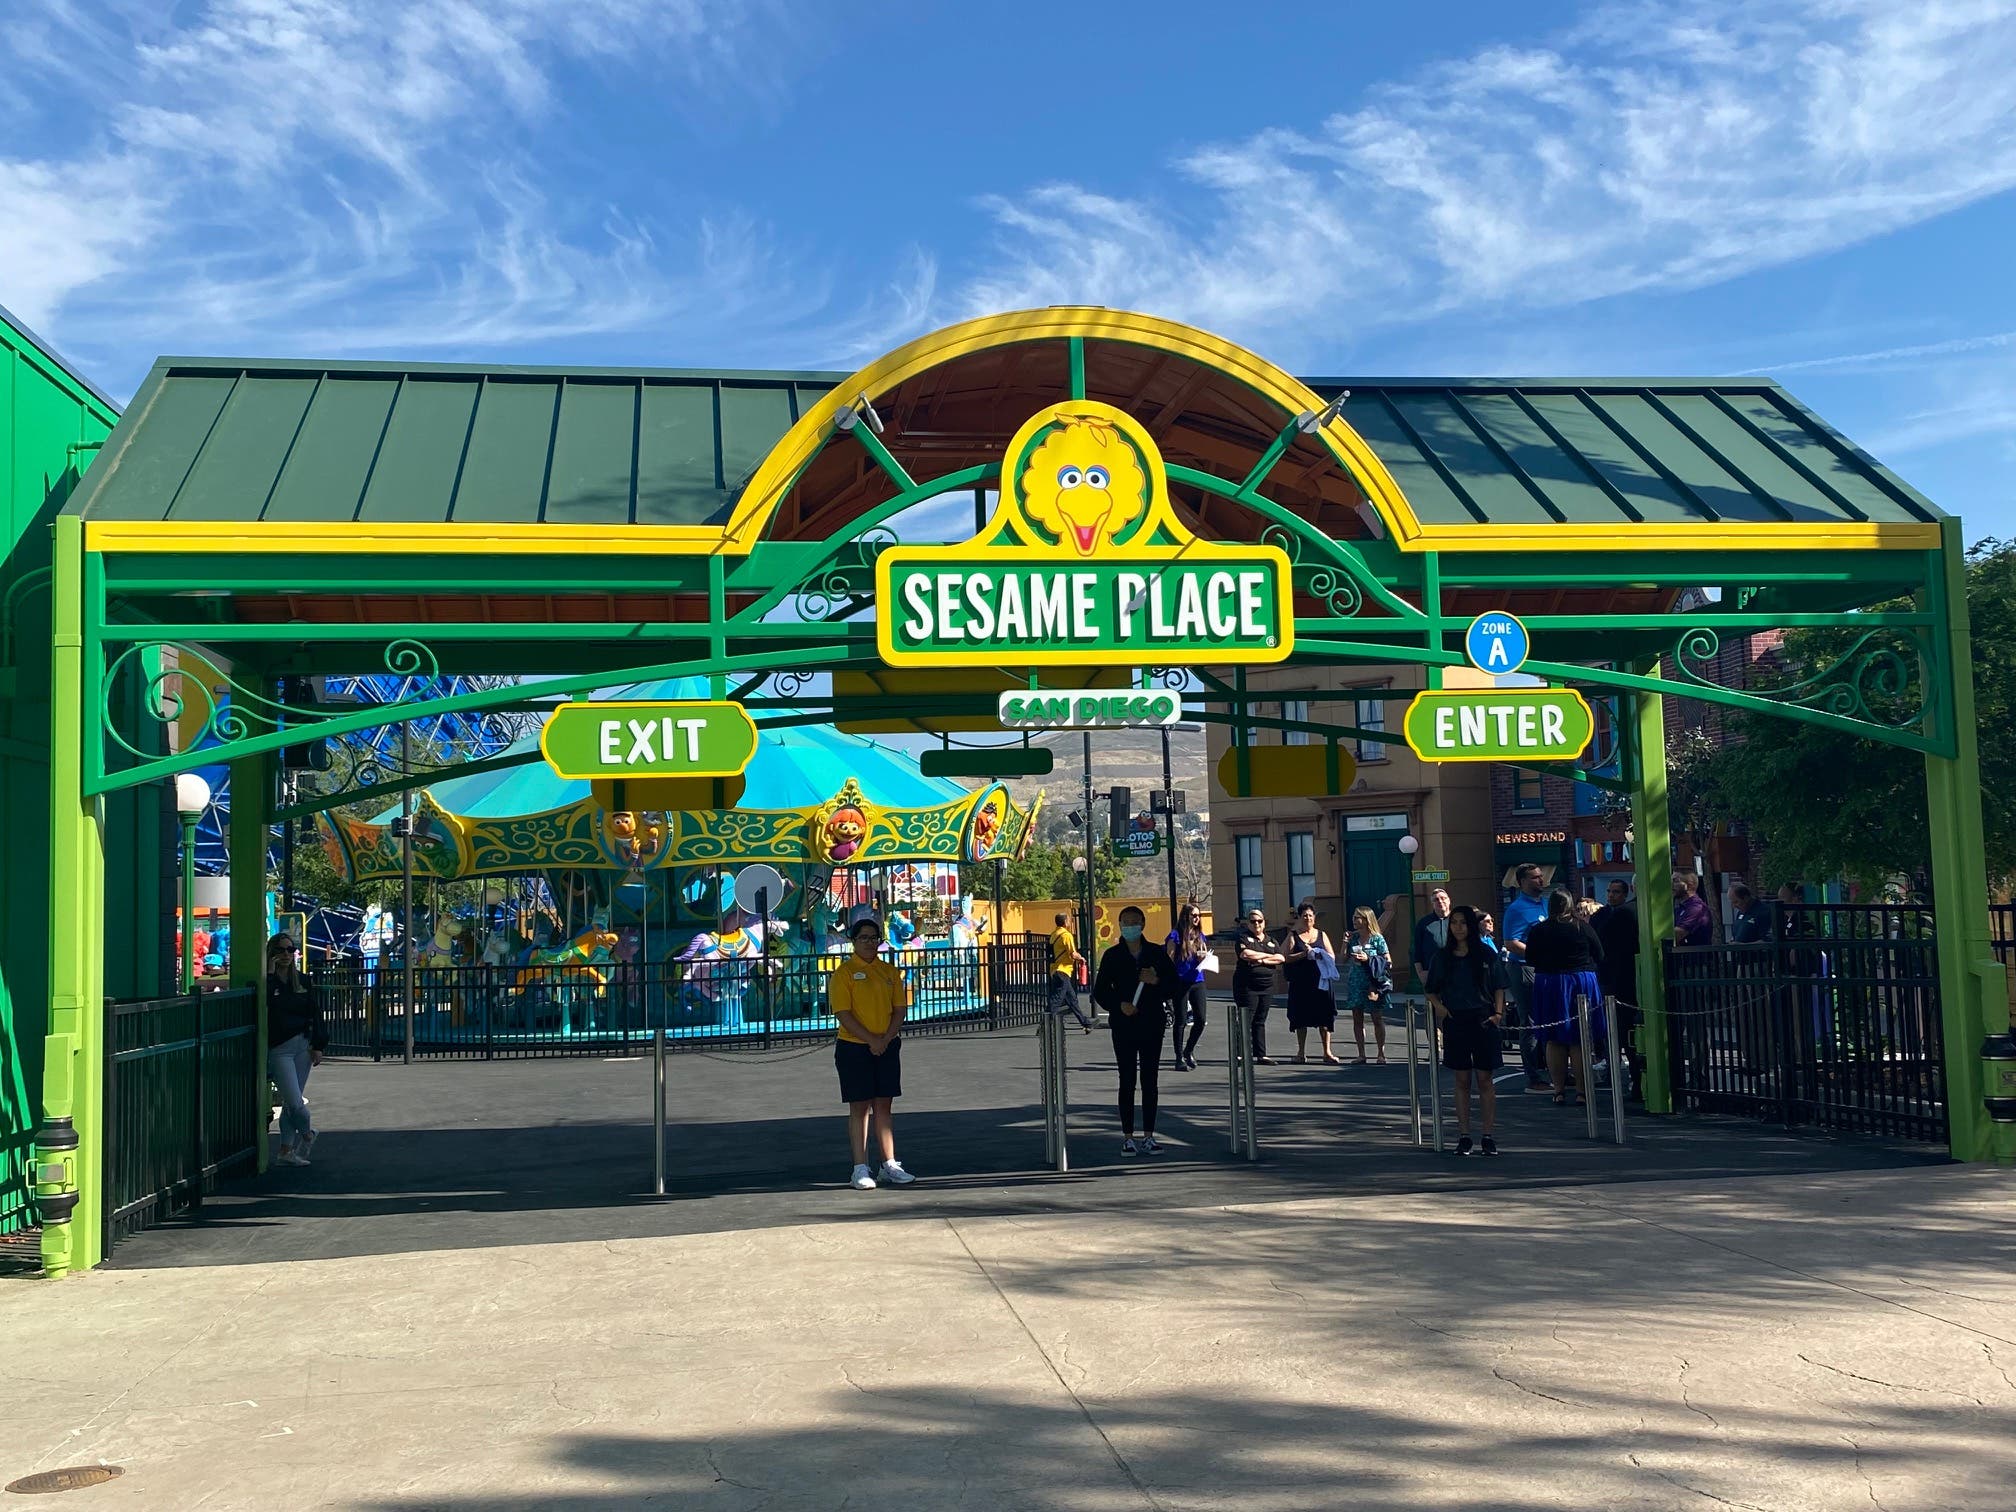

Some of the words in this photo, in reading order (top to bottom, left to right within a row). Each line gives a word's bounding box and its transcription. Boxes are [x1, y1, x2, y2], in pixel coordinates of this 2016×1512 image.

[902, 572, 1100, 640] SESAME
[1116, 571, 1268, 638] PLACE
[1481, 622, 1512, 635] ZONE
[1488, 637, 1509, 667] A
[1006, 697, 1071, 720] SAN
[1078, 696, 1174, 720] DIEGO
[1435, 704, 1567, 748] ENTER
[600, 717, 707, 765] EXIT
[1129, 841, 1153, 850] ELMO
[1496, 832, 1566, 844] NEWSSTAND
